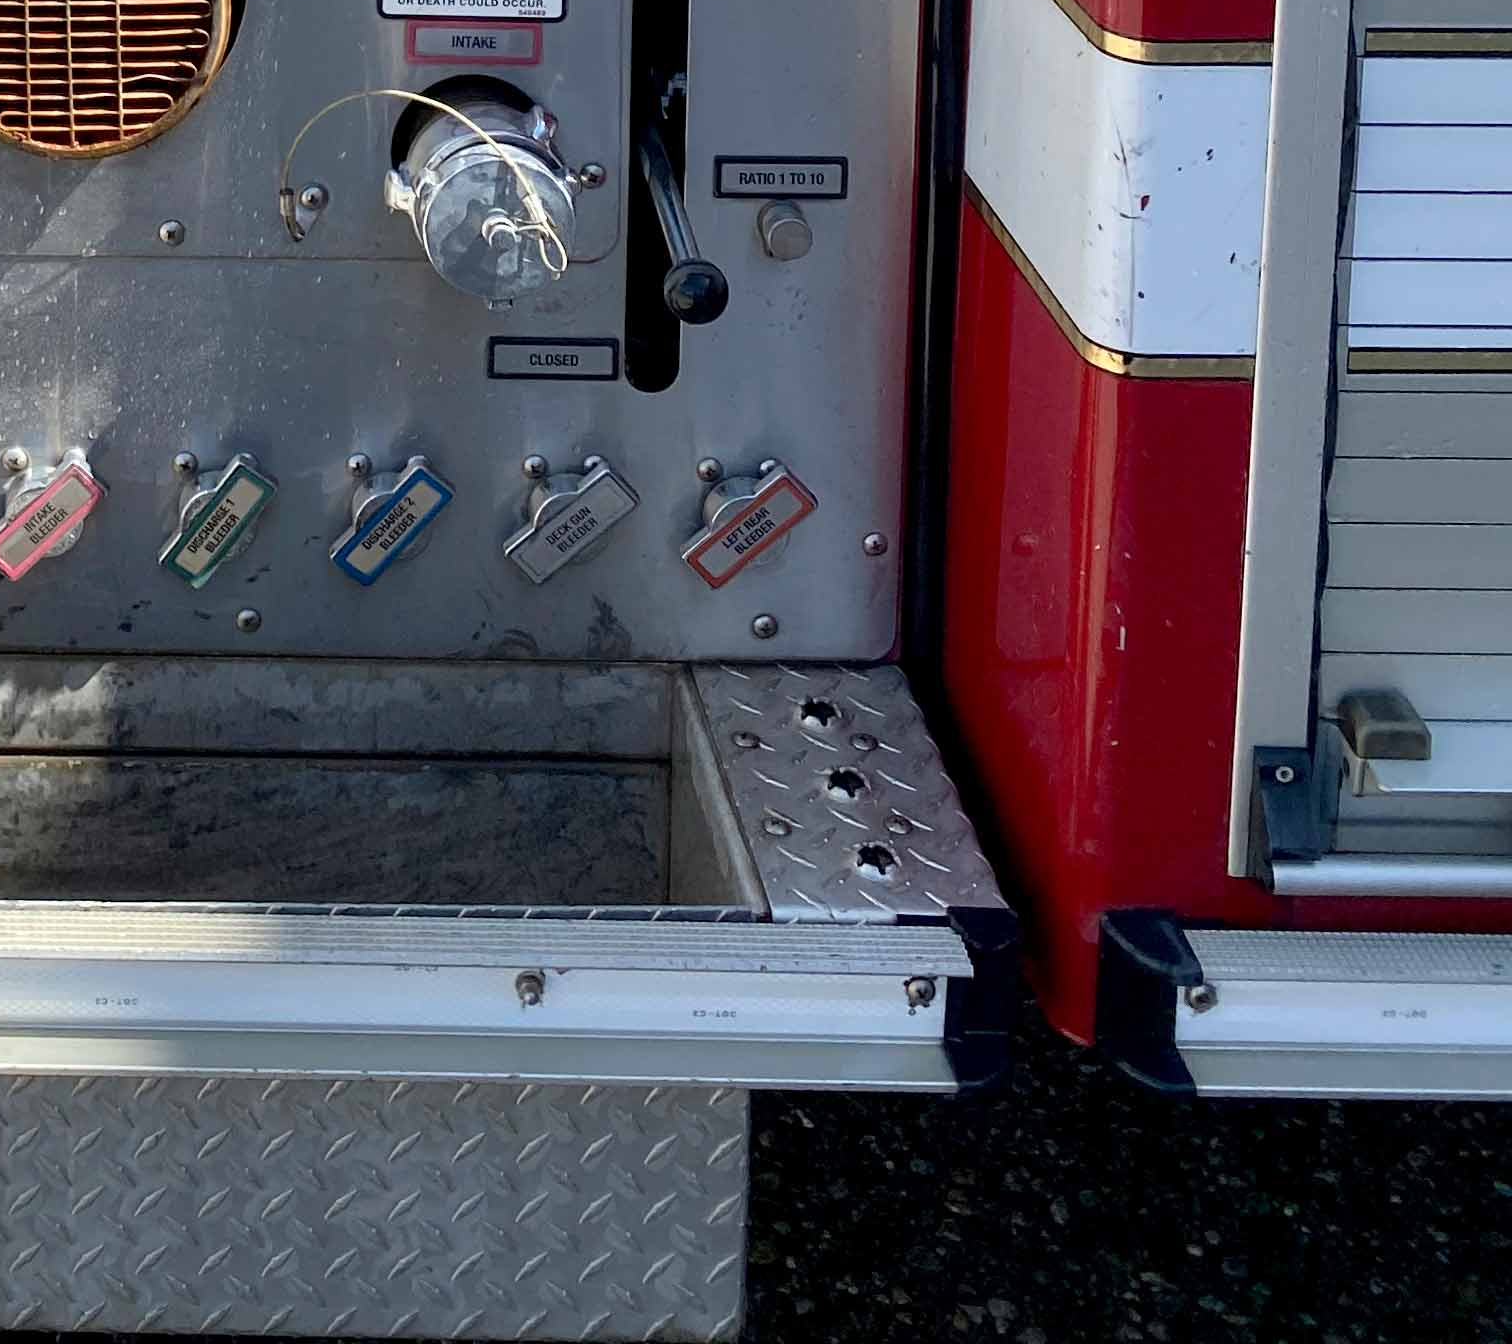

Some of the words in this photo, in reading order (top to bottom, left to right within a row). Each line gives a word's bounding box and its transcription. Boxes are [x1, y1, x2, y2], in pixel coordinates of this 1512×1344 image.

[502, 0, 546, 8] OCCUR.
[451, 35, 497, 49] INTAKE
[739, 171, 777, 185] RATIO
[789, 172, 806, 185] TO
[809, 172, 825, 185] 10
[529, 353, 579, 367] CLOSED
[24, 502, 56, 534] INTAKE
[29, 508, 69, 545] BLEEDER
[187, 505, 227, 554] DISCHARGE
[205, 515, 240, 553] BLEEDER
[362, 507, 407, 551] DISCHARGE
[380, 512, 417, 552] BLEEDER
[545, 519, 574, 545] DECK
[570, 506, 592, 526] GUN
[558, 517, 599, 553] BLEEDER
[722, 523, 749, 549] LEFT
[744, 507, 771, 530] REAR
[735, 519, 776, 555] BLEEDER
